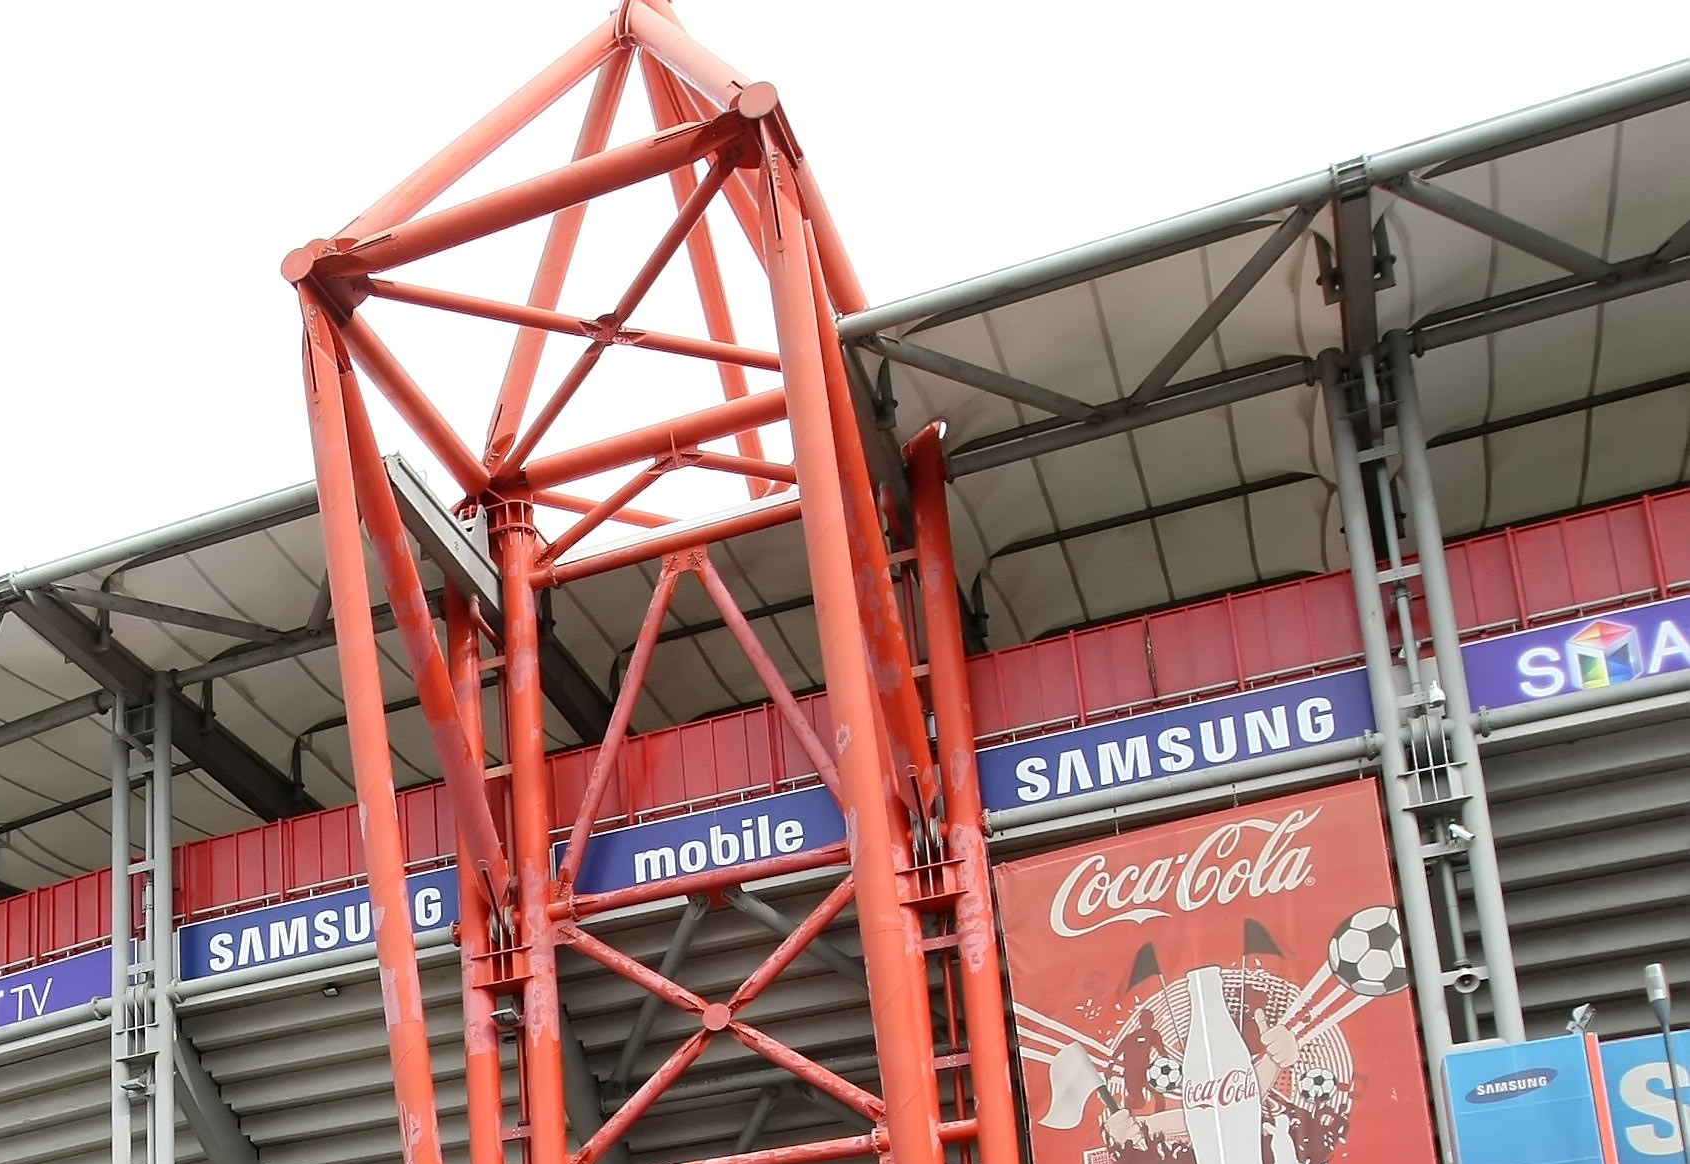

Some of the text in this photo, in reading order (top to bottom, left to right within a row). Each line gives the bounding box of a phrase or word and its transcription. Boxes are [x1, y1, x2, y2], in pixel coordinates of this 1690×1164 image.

[1015, 697, 1335, 801] SAMSUNG
[634, 815, 804, 884] mobile
[1049, 805, 1322, 937] Coca-Cola
[208, 887, 442, 972] SAMSUG
[10, 977, 53, 1021] TV
[1184, 1068, 1257, 1110] Coca-Cola
[1476, 1076, 1548, 1096] SAMSUNG
